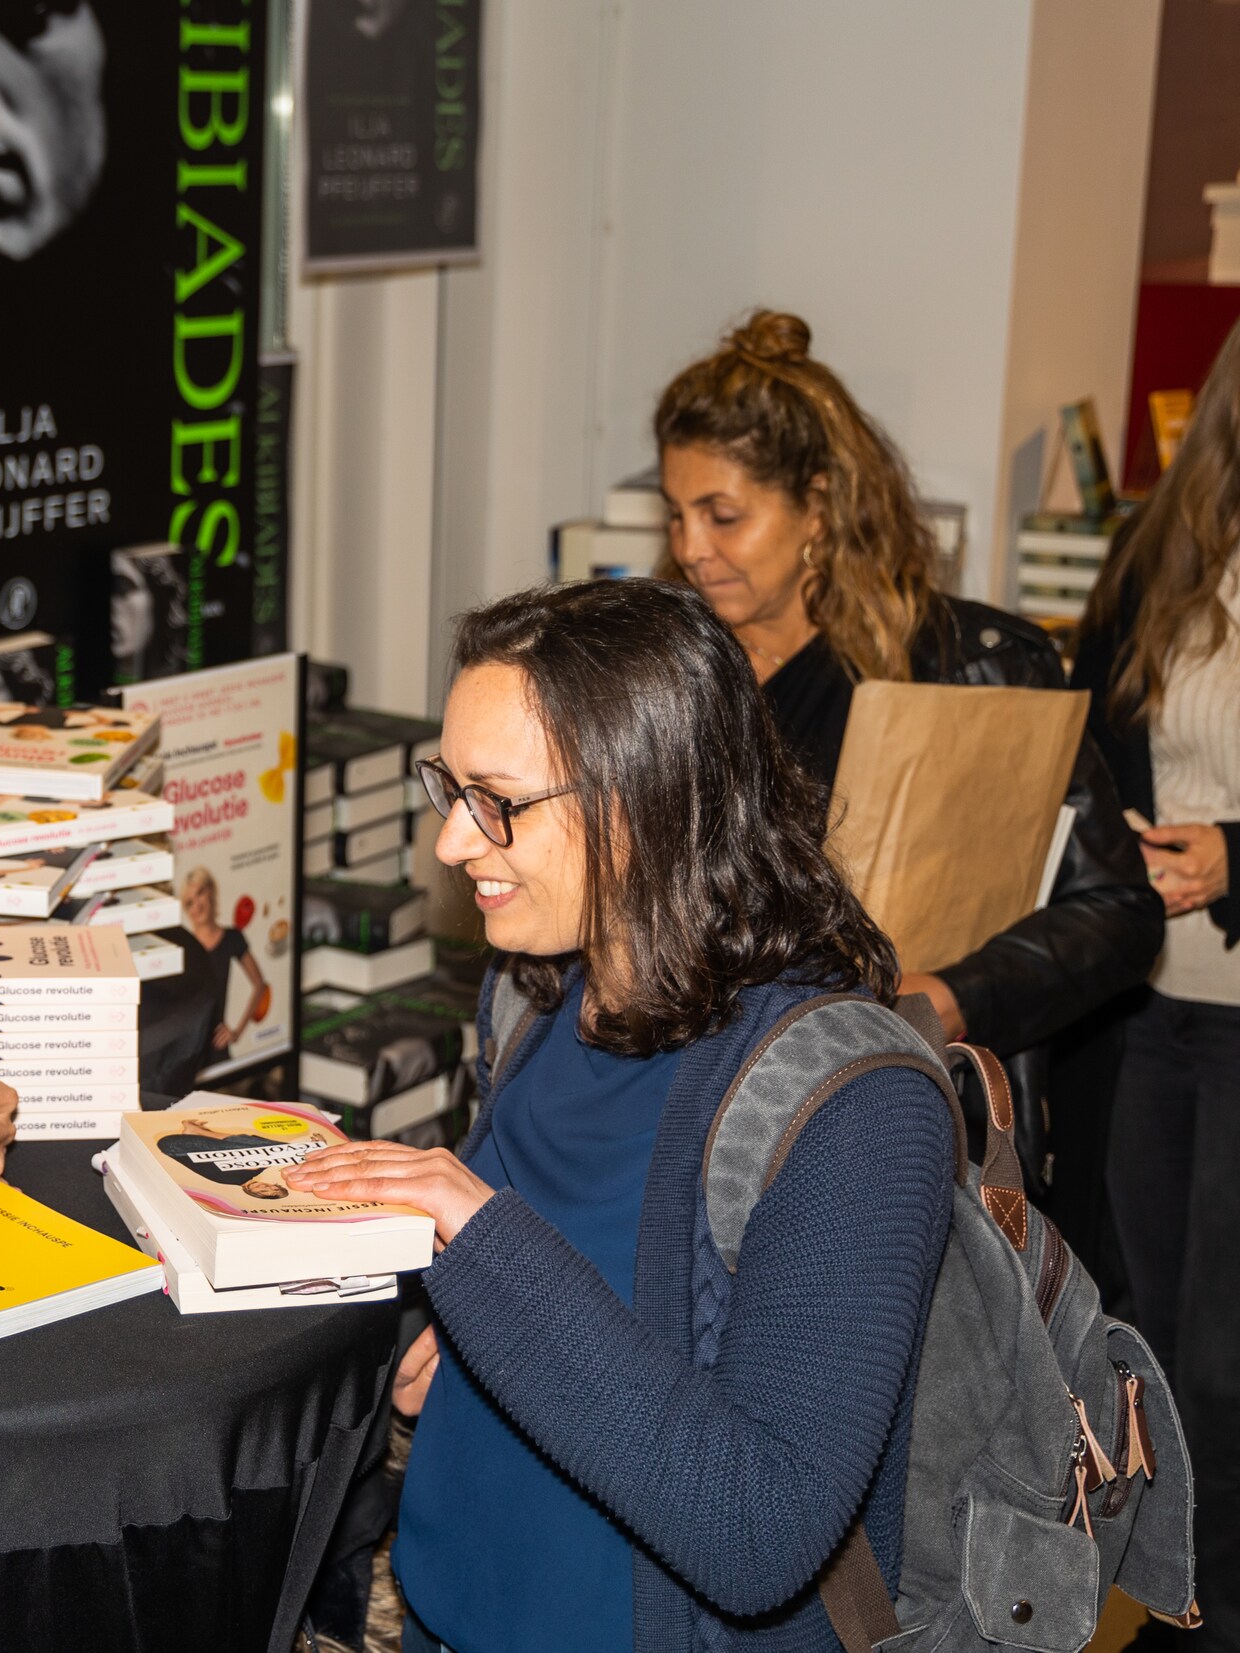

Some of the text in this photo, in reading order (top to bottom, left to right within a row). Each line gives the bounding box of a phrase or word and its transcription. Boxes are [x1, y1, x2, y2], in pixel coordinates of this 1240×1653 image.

[162, 769, 247, 805] Glucose
[167, 795, 250, 838] evolutie
[46, 985, 93, 996] revolutie
[44, 1011, 91, 1022] revolutie
[44, 1039, 92, 1050] revolutie
[45, 1066, 92, 1077] revolutie
[17, 1092, 93, 1104] cose revolutie
[16, 1119, 96, 1131] ucose revolutie
[16, 1219, 74, 1249] INCHAUSPÉ
